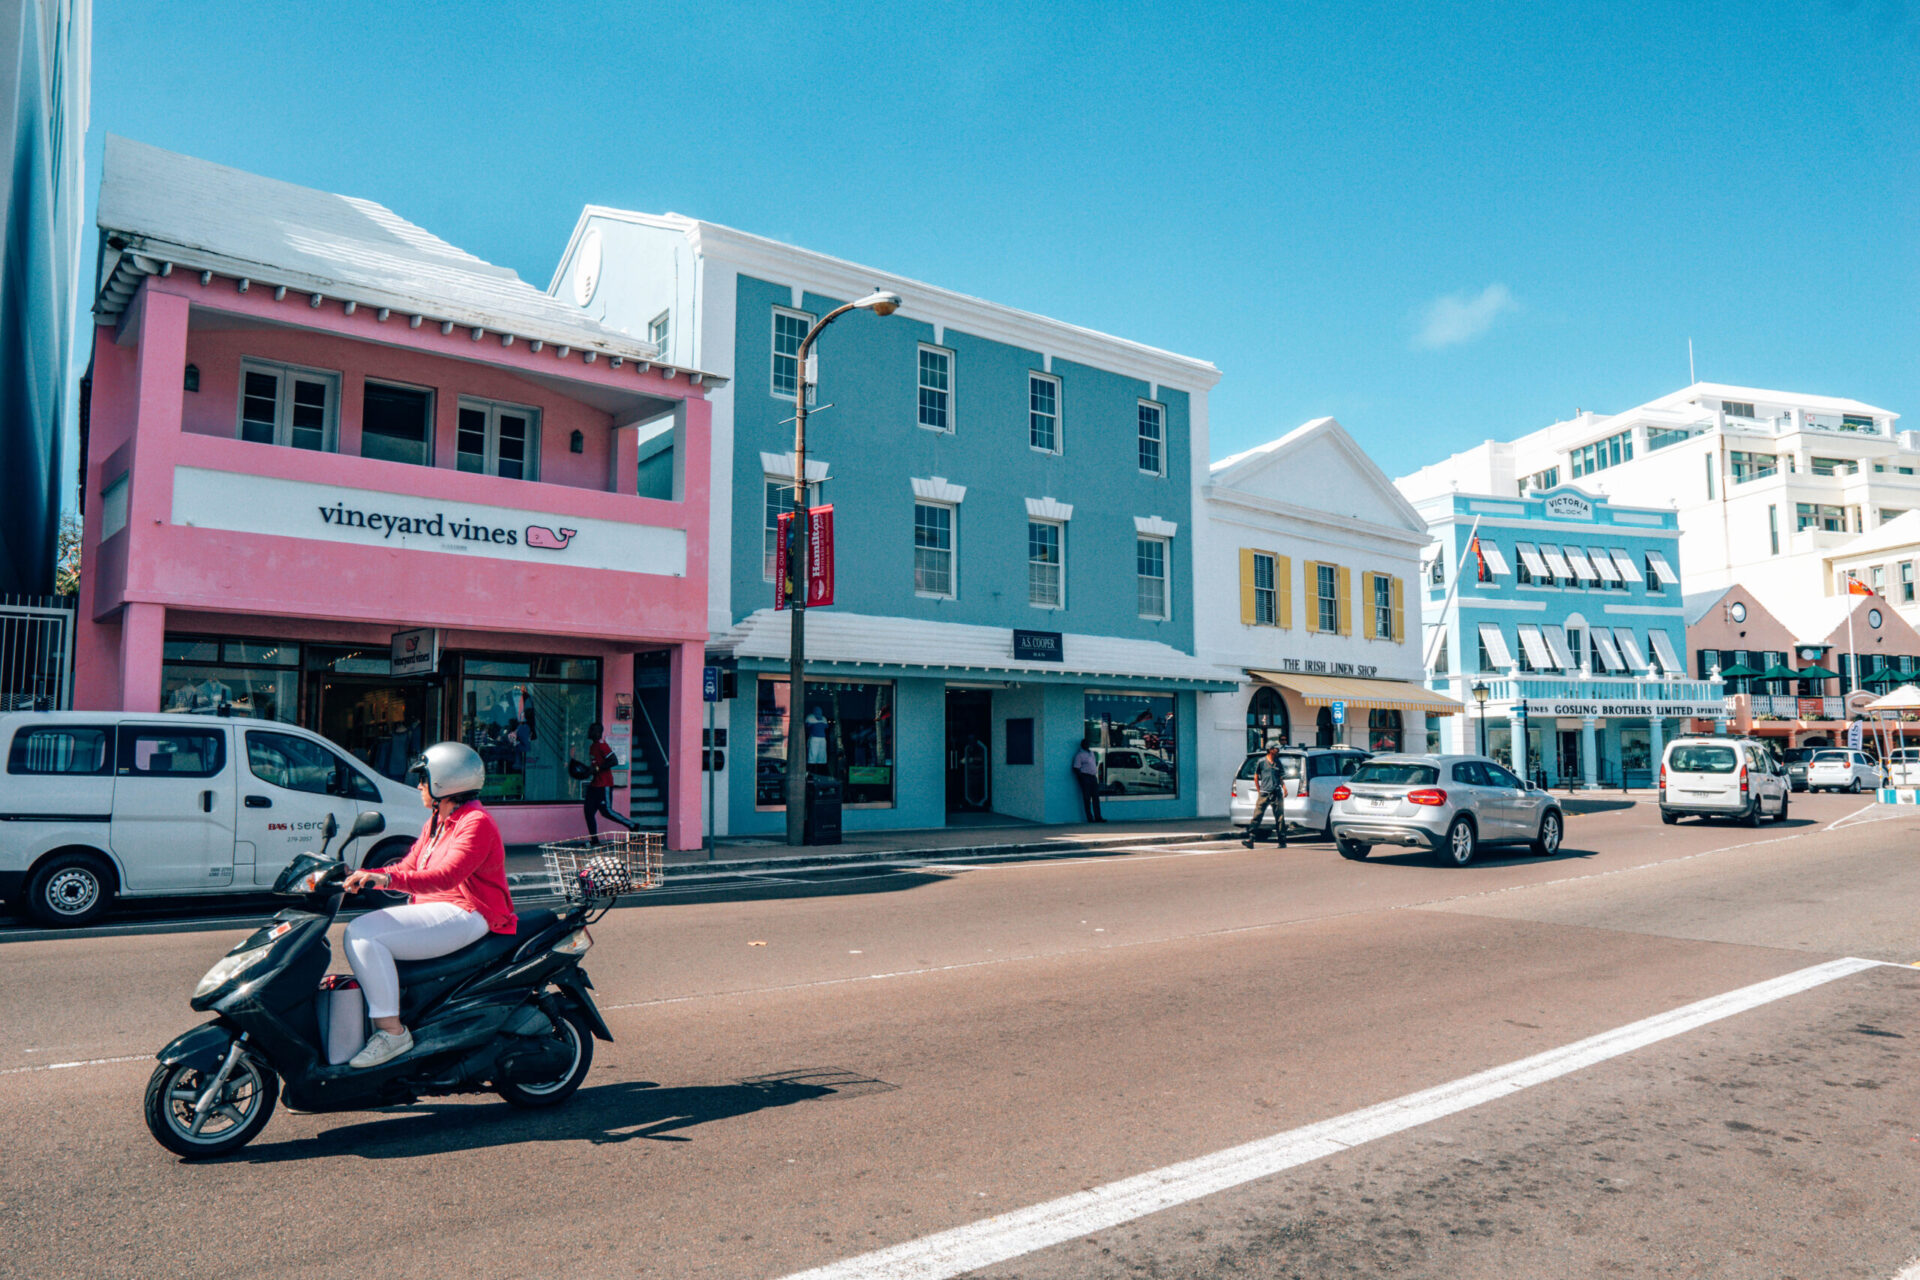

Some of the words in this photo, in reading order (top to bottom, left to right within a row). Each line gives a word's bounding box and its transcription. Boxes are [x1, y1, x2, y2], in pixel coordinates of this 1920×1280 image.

[1549, 498, 1588, 512] VICTORIA
[318, 502, 444, 539] vineyard
[448, 518, 518, 545] vines
[812, 514, 820, 577] Hamilton
[1032, 638, 1055, 649] COOPER
[1283, 659, 1300, 671] THE
[1304, 660, 1326, 673] IRISH
[1330, 662, 1354, 675] LINEN
[1357, 664, 1377, 677] SHOP
[1554, 705, 1598, 715] GOSLING
[1602, 705, 1652, 716] BROTHERS
[1656, 706, 1693, 716] LIMITED
[1696, 707, 1723, 715] SPIRITS
[268, 823, 287, 831] BAS
[297, 821, 331, 830] serc
